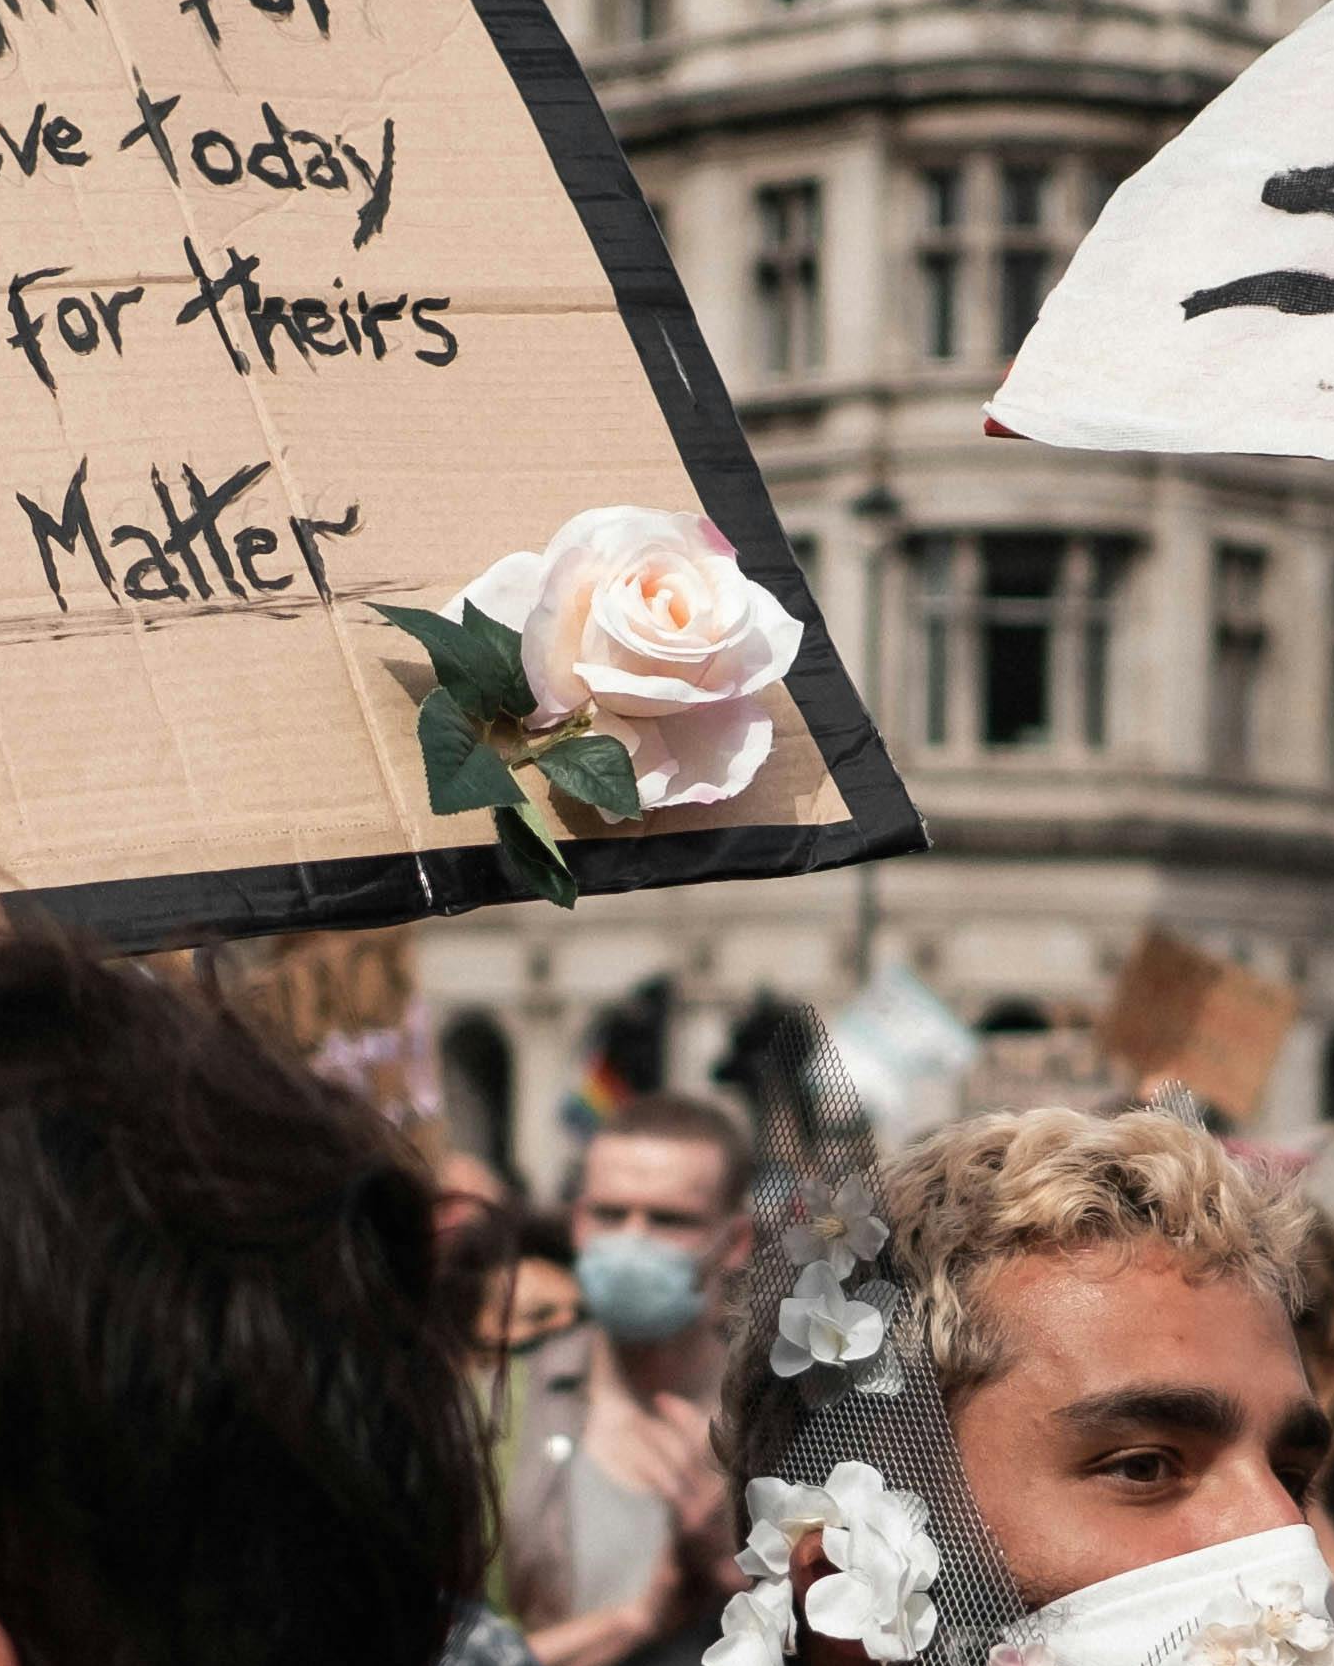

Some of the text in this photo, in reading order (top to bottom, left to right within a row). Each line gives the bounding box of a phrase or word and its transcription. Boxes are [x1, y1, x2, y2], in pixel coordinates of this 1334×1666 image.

[120, 68, 396, 250] today
[175, 235, 459, 375] theirs
[16, 455, 360, 611] Matter
